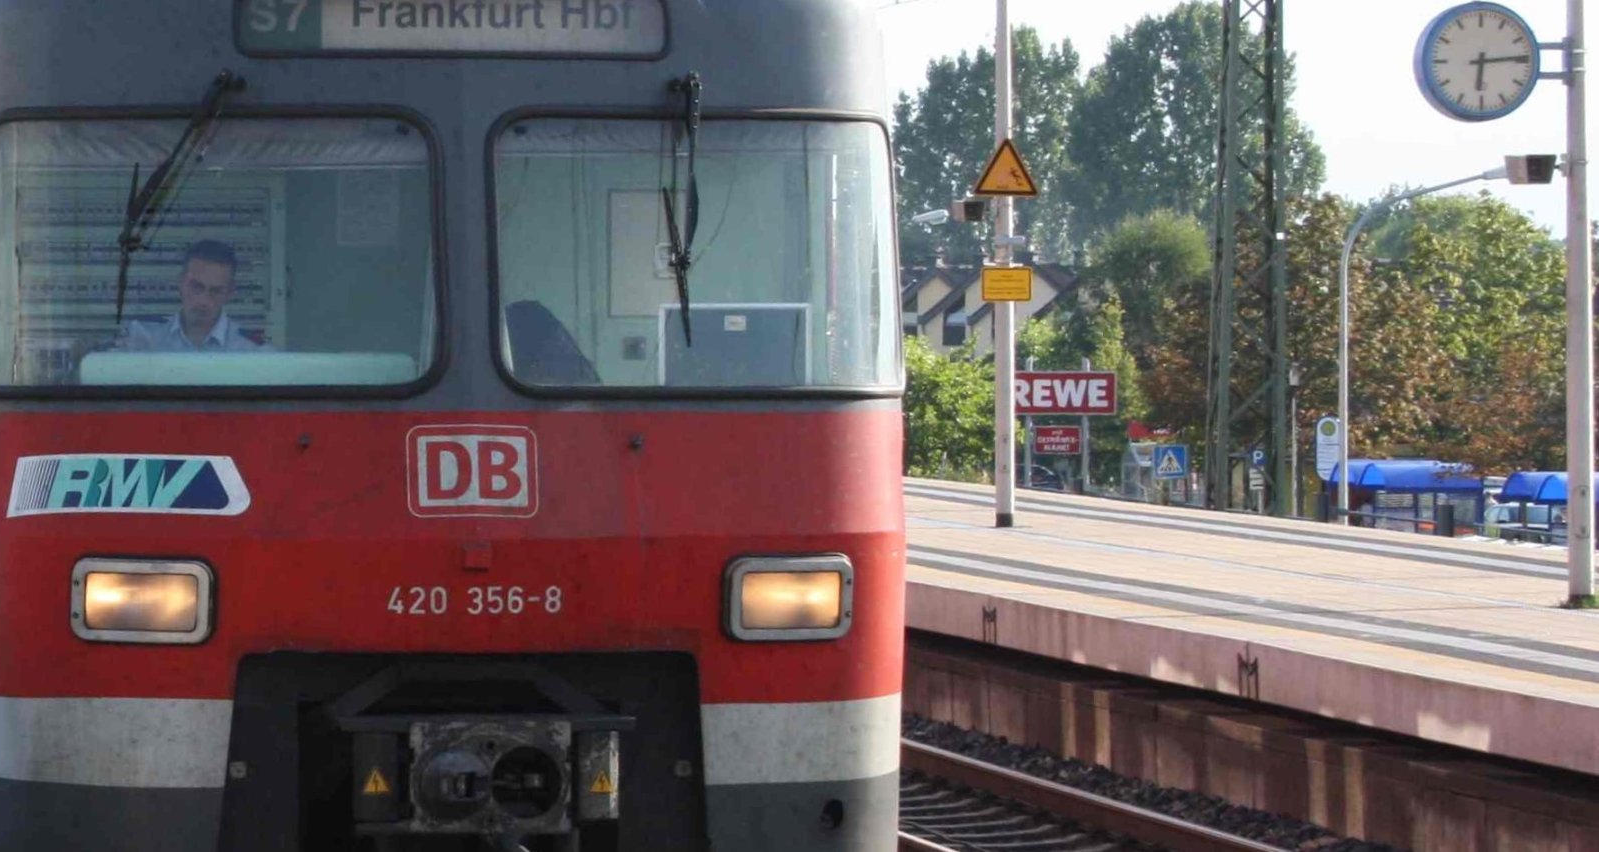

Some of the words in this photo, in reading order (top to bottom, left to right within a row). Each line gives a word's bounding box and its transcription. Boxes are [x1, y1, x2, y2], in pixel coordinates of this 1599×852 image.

[250, 0, 309, 32] S7
[352, 0, 545, 29] Frankfurt
[561, 0, 639, 29] Hbf
[1013, 378, 1108, 408] REWE
[425, 441, 522, 500] DB
[1253, 450, 1264, 465] P
[387, 587, 448, 615] 420
[466, 586, 562, 615] 356-8
